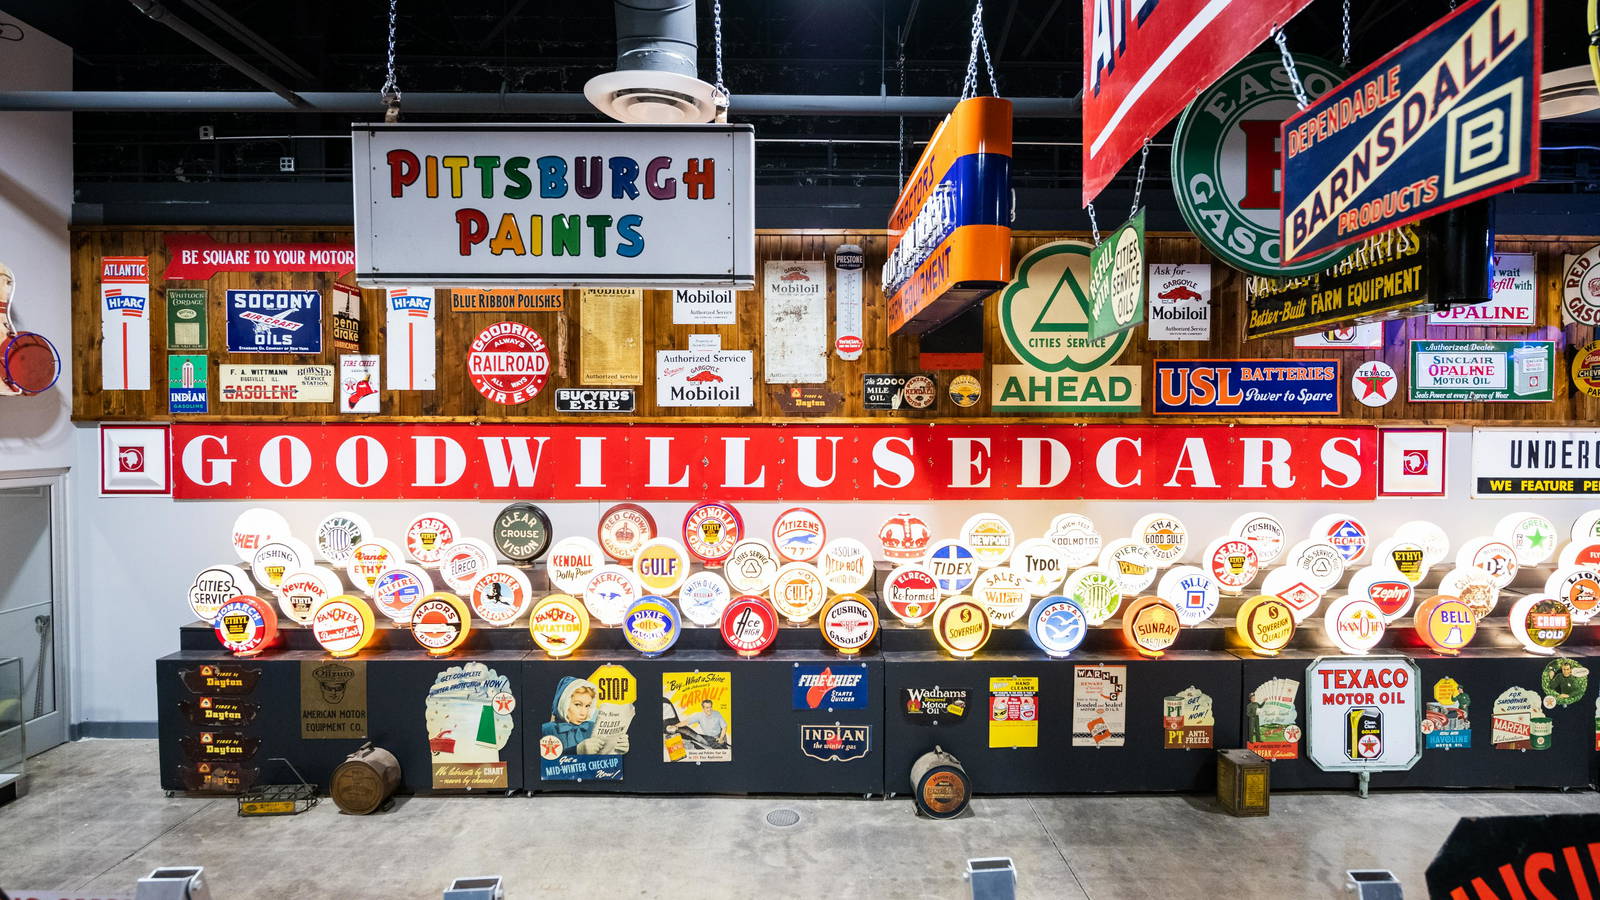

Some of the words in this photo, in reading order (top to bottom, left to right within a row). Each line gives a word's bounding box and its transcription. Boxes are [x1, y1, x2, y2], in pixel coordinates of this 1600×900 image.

[1204, 65, 1334, 124] EASO
[1288, 65, 1400, 159] DEPENDABLE
[1293, 4, 1516, 245] BARNSDALL
[386, 149, 715, 200] PITTSBURGH
[897, 155, 935, 229] TRACTORS
[1338, 176, 1439, 236] PRODUCTS
[455, 208, 644, 257] PAINTS
[182, 250, 198, 264] BE
[203, 250, 250, 265] SQUARE
[254, 250, 269, 264] TO
[272, 250, 305, 264] YOUR
[836, 255, 863, 263] PRESTONE
[1116, 239, 1137, 271] CITIES
[104, 264, 145, 276] ATLANTIC
[1090, 242, 1113, 300] REFILL
[1153, 266, 1171, 276] Ask
[1499, 268, 1520, 277] wait
[1567, 257, 1590, 288] RED
[904, 246, 951, 314] EQUIPMENT
[1113, 262, 1139, 297] SERVICE
[1162, 279, 1198, 290] GARGOYLE
[1514, 279, 1532, 290] with
[771, 284, 819, 293] Mobiloil
[109, 297, 144, 308] HI-ARC
[235, 294, 315, 309] SOCONY
[454, 294, 476, 307] BLUE
[479, 294, 515, 308] RIBBON
[518, 294, 561, 308] POLISHES
[676, 290, 732, 303] Mobiloil
[1250, 298, 1307, 328] Better-Built
[1311, 288, 1342, 315] FARM
[1348, 265, 1422, 307] EQUIPMENT
[395, 298, 430, 309] HI-ARC
[1118, 292, 1133, 318] OILS
[1152, 305, 1207, 320] Mobiloil
[1437, 306, 1529, 320] OPALINE
[334, 317, 359, 331] penn
[255, 334, 292, 345] OILS
[334, 328, 359, 341] drake
[473, 323, 544, 351] GOODRICH
[494, 338, 525, 348] ALWAYS
[1029, 338, 1061, 347] CITIES
[1425, 343, 1469, 351] Authorized
[1471, 343, 1495, 351] Dealer
[473, 355, 545, 372] RAILROAD
[664, 355, 710, 363] Authorized
[713, 355, 746, 363] Service
[1433, 356, 1493, 364] SINCLAIR
[690, 365, 720, 373] GARGOYLE
[1241, 367, 1335, 381] BATTERIES
[1428, 364, 1495, 376] OPALINE
[491, 377, 504, 388] ALL
[511, 377, 528, 388] WAYS
[1160, 367, 1244, 406] USL
[1433, 377, 1469, 385] MOTOR
[1473, 377, 1491, 385] OIL
[225, 385, 297, 399] GASOLENE
[480, 381, 538, 403] TIRES
[671, 386, 739, 400] Mobiloil
[1000, 376, 1132, 402] AHEAD
[171, 391, 205, 402] INDIAN
[560, 391, 629, 404] BUCYRUS
[1246, 388, 1282, 402] Power
[1284, 390, 1294, 401] to
[1298, 388, 1332, 404] Spare
[570, 400, 620, 410] ERIE
[796, 399, 825, 407] Dayton
[1510, 440, 1600, 469] UNDER
[1490, 480, 1512, 491] WE
[1521, 480, 1574, 491] FEATURE
[501, 512, 537, 528] CLEAR
[605, 513, 620, 530] RED
[623, 512, 648, 534] CROWN
[689, 508, 737, 531] MAGNOLIA
[501, 530, 539, 538] CROUSE
[778, 520, 819, 537] CITIZENS
[1151, 521, 1179, 534] THAT
[1247, 523, 1281, 537] CUSHING
[1145, 534, 1164, 544] GOOD
[1166, 534, 1184, 544] GULF
[502, 540, 540, 556] VISION
[1115, 546, 1149, 560] PIERCE
[257, 550, 293, 563] CUSHING
[553, 555, 592, 567] KENDALL
[1395, 552, 1422, 560] ETHYL
[640, 558, 677, 576] GULF
[934, 562, 972, 575] TIDEX
[1026, 555, 1061, 572] TYDOL
[476, 573, 520, 592] HI-POWER
[589, 574, 632, 596] AMERICAN
[899, 573, 931, 584] ELRECO
[986, 572, 1022, 586] SALES
[1181, 577, 1210, 591] BLUE
[199, 580, 230, 592] CITIES
[985, 591, 1023, 604] Willard
[1371, 586, 1408, 602] Zephyr
[216, 601, 261, 620] MONARCH
[416, 603, 456, 619] MAJORS
[634, 610, 663, 620] DIXIE
[831, 606, 867, 618] CUSHING
[1040, 604, 1081, 622] COASTAL
[1441, 610, 1470, 624] BELL
[224, 616, 249, 624] ETHYL
[1537, 616, 1567, 627] CROWN
[534, 624, 580, 632] AVIATION
[949, 622, 983, 639] SOVEREIGN
[1138, 625, 1177, 636] SUNRAY
[1257, 619, 1289, 635] SOVEREIGN
[830, 631, 868, 644] GASOLINE
[1538, 630, 1564, 639] GOLD
[207, 678, 243, 687] Dayton
[483, 680, 507, 688] NOW!
[1318, 668, 1409, 689] TEXACO
[598, 678, 629, 701] STOP
[907, 688, 966, 702] Wadhams
[1187, 696, 1200, 705] GET
[1322, 693, 1375, 705] MOTOR
[1380, 692, 1405, 705] OIL
[205, 710, 241, 720] Dayton
[303, 710, 337, 718] AMERICAN
[339, 710, 366, 718] MOTOR
[1167, 706, 1183, 716] PT
[306, 723, 346, 732] EQUIPMENT
[350, 723, 364, 732] CO.
[1494, 718, 1530, 736] MARFAK
[805, 727, 865, 741] INDIAN
[1168, 731, 1185, 744] PT
[1188, 730, 1207, 738] ANTI-
[1430, 735, 1468, 743] HAVOLINE
[206, 746, 242, 755] Dayton
[846, 743, 857, 751] gas
[484, 767, 504, 775] CHART
[546, 763, 587, 777] MID-WINTER
[589, 759, 619, 770] CHECK-UP
